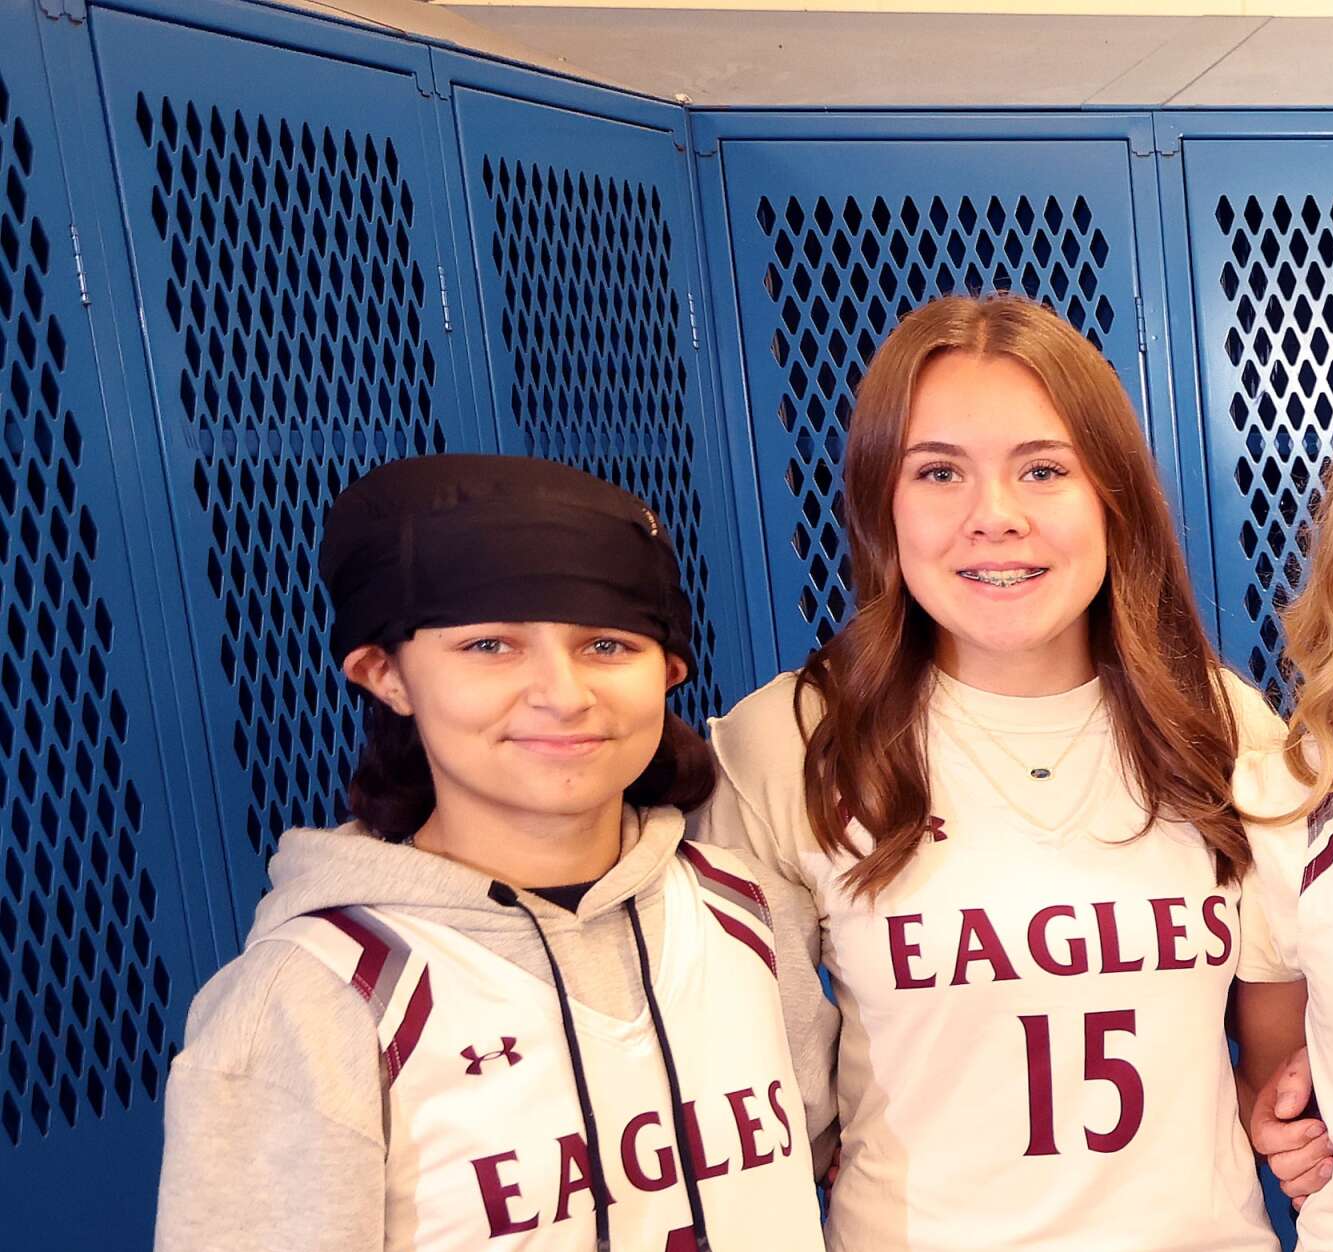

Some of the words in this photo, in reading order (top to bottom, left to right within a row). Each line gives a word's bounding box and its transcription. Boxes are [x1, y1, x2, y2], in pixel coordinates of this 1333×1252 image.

[885, 895, 1232, 990] EAGLES
[1016, 1008, 1145, 1157] 15
[469, 1080, 793, 1239] EAGLES
